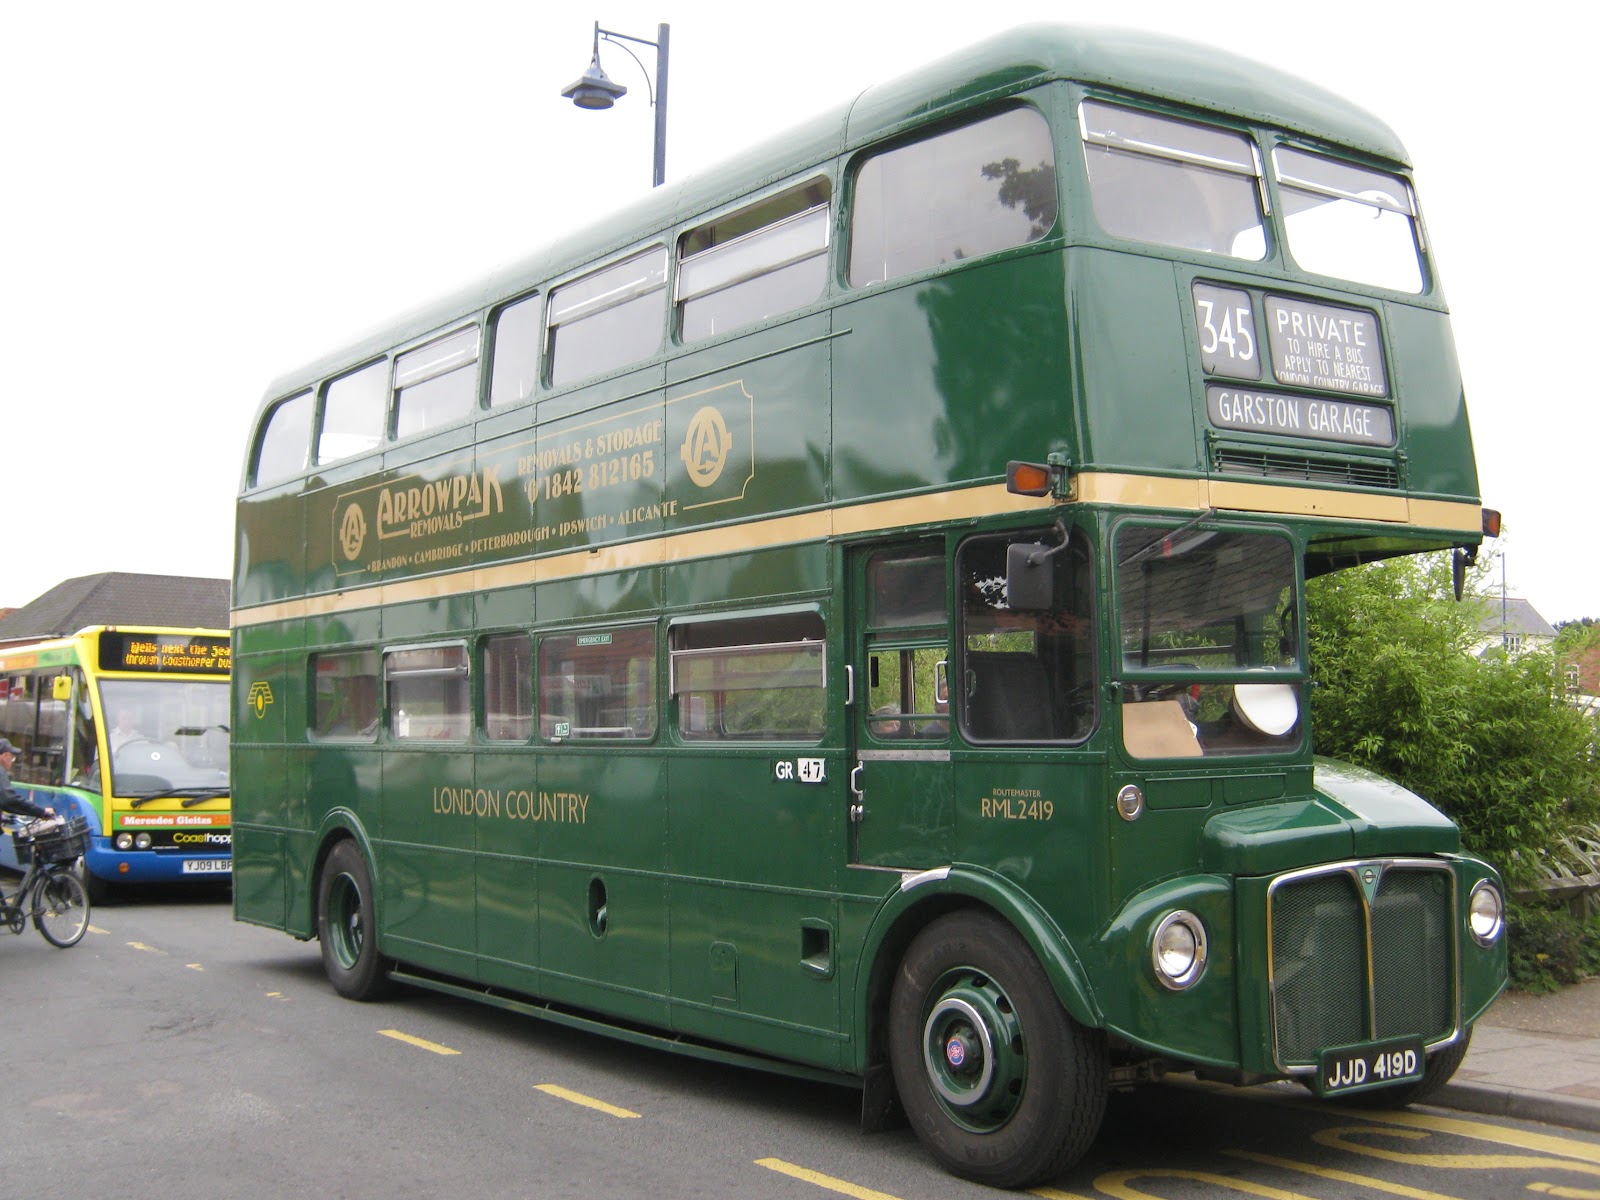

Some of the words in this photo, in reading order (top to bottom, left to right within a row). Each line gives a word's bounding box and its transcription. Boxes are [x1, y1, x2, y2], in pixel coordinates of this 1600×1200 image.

[1198, 300, 1254, 361] 345
[1276, 309, 1366, 347] PRIVATE
[1287, 338, 1300, 354] TO
[1307, 341, 1329, 360] HIRE
[1334, 346, 1342, 361] A
[1346, 348, 1364, 364] BUS
[1284, 355, 1312, 373] APPLY
[1316, 359, 1330, 376] TO
[1333, 361, 1370, 382] NEAREST
[1218, 392, 1300, 429] GARSTON
[1308, 402, 1373, 437] GARAGE
[518, 441, 582, 476] REMOVALS
[585, 437, 593, 458] &
[597, 419, 662, 456] STORAGE
[588, 450, 655, 490] 812165
[377, 464, 504, 538] ARROWPAK
[371, 556, 408, 573] BRANDON
[414, 543, 464, 565] CAMBRIDGE
[470, 526, 550, 554] PETERBOROUGH
[560, 514, 607, 537] IPSWICH
[617, 500, 678, 526] ALICANTE
[410, 510, 464, 539] REMOVALS
[126, 653, 159, 665] through
[161, 644, 185, 654] next
[189, 644, 208, 655] the
[775, 761, 793, 779] GR
[803, 761, 820, 778] 47
[433, 786, 500, 818] LONDON
[505, 790, 590, 824] COUNTRY
[992, 787, 1041, 798] ROUTEMASTER
[124, 816, 174, 825] Mercedes
[981, 797, 1054, 821] RML2419
[187, 861, 212, 871] YJ09
[1328, 1058, 1367, 1087] JJD
[1373, 1049, 1417, 1079] 419D
